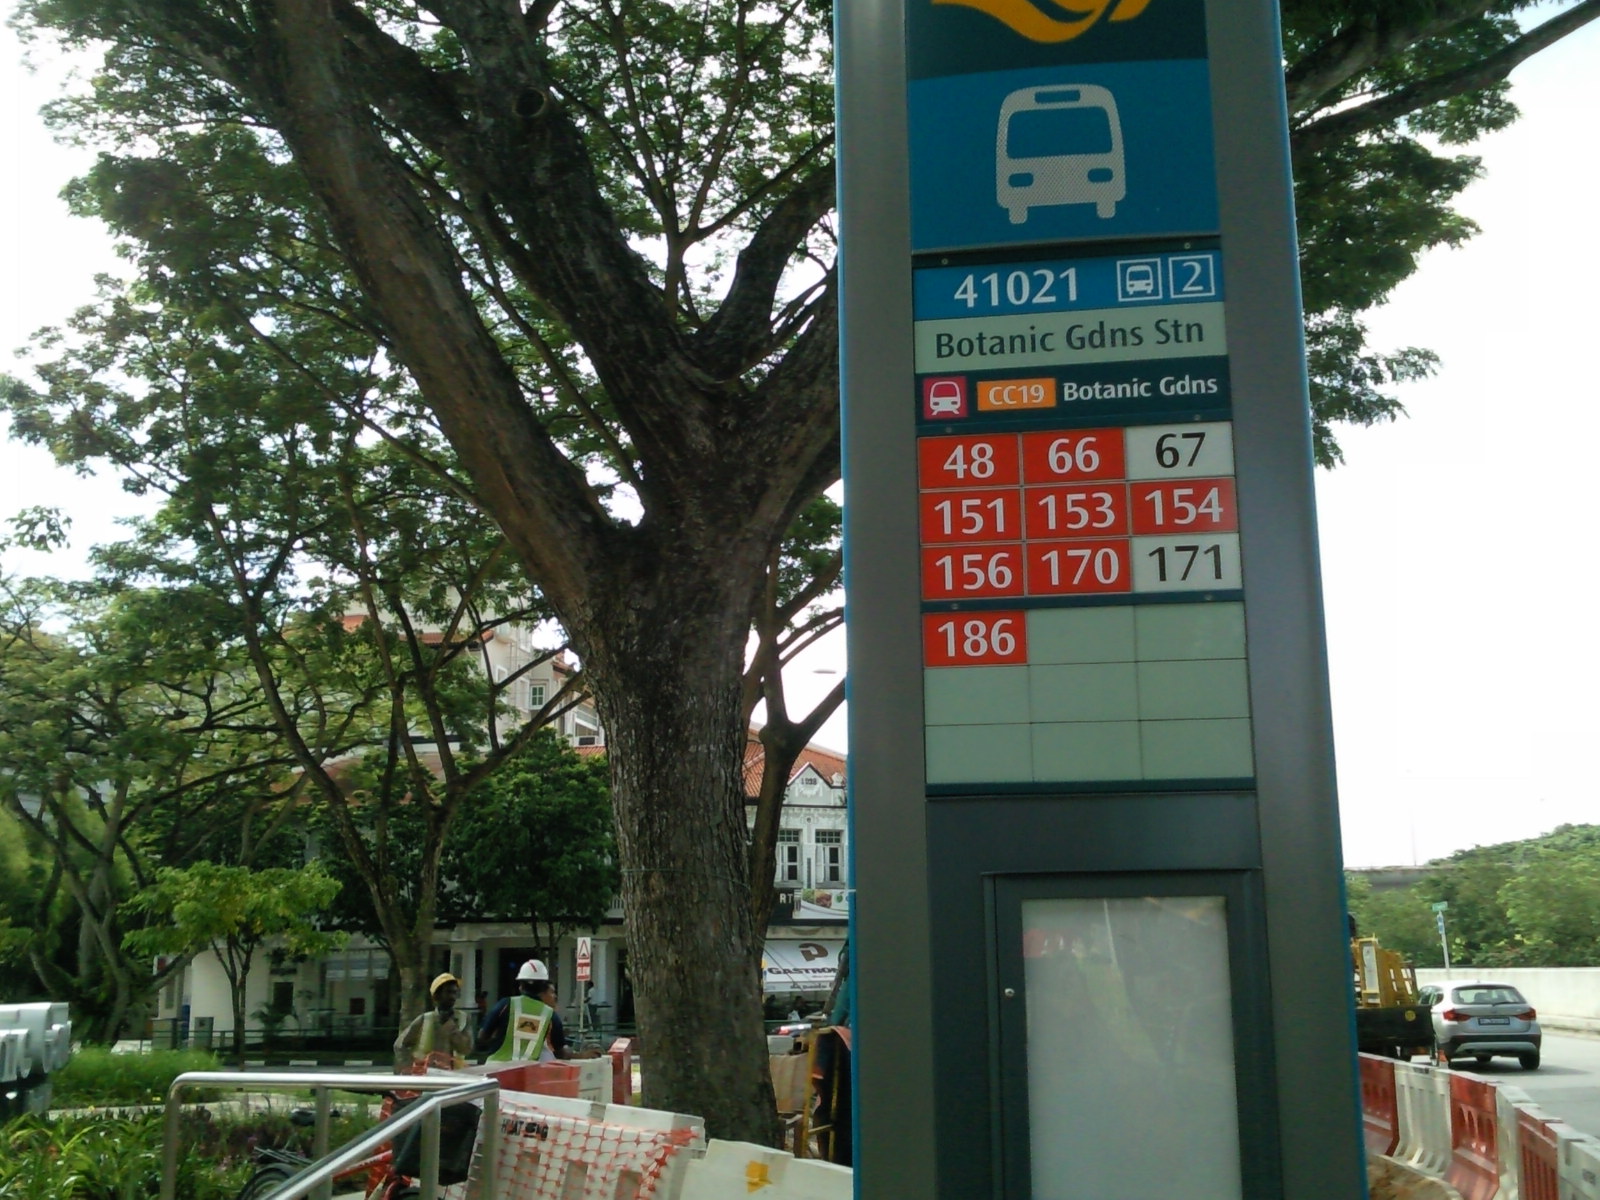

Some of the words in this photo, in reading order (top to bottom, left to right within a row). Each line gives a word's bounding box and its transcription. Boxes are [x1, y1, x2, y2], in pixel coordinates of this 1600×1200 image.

[955, 268, 1077, 307] 41021
[1182, 262, 1203, 292] 2
[936, 326, 1055, 358] Botanic
[1065, 321, 1143, 350] Gdns
[1155, 318, 1204, 344] Stn
[989, 385, 1044, 405] CC19
[1063, 378, 1150, 401] Botanic
[1159, 375, 1217, 395] Gdns
[943, 443, 994, 478] 48
[1048, 437, 1099, 473] 66
[1155, 432, 1205, 468] 67
[934, 498, 1004, 534] 151
[1038, 492, 1115, 529] 153
[1144, 487, 1223, 525] 154
[935, 553, 1012, 590] 156
[1041, 548, 1119, 585] 170
[1149, 544, 1222, 581] 171
[938, 619, 1015, 656] 186
